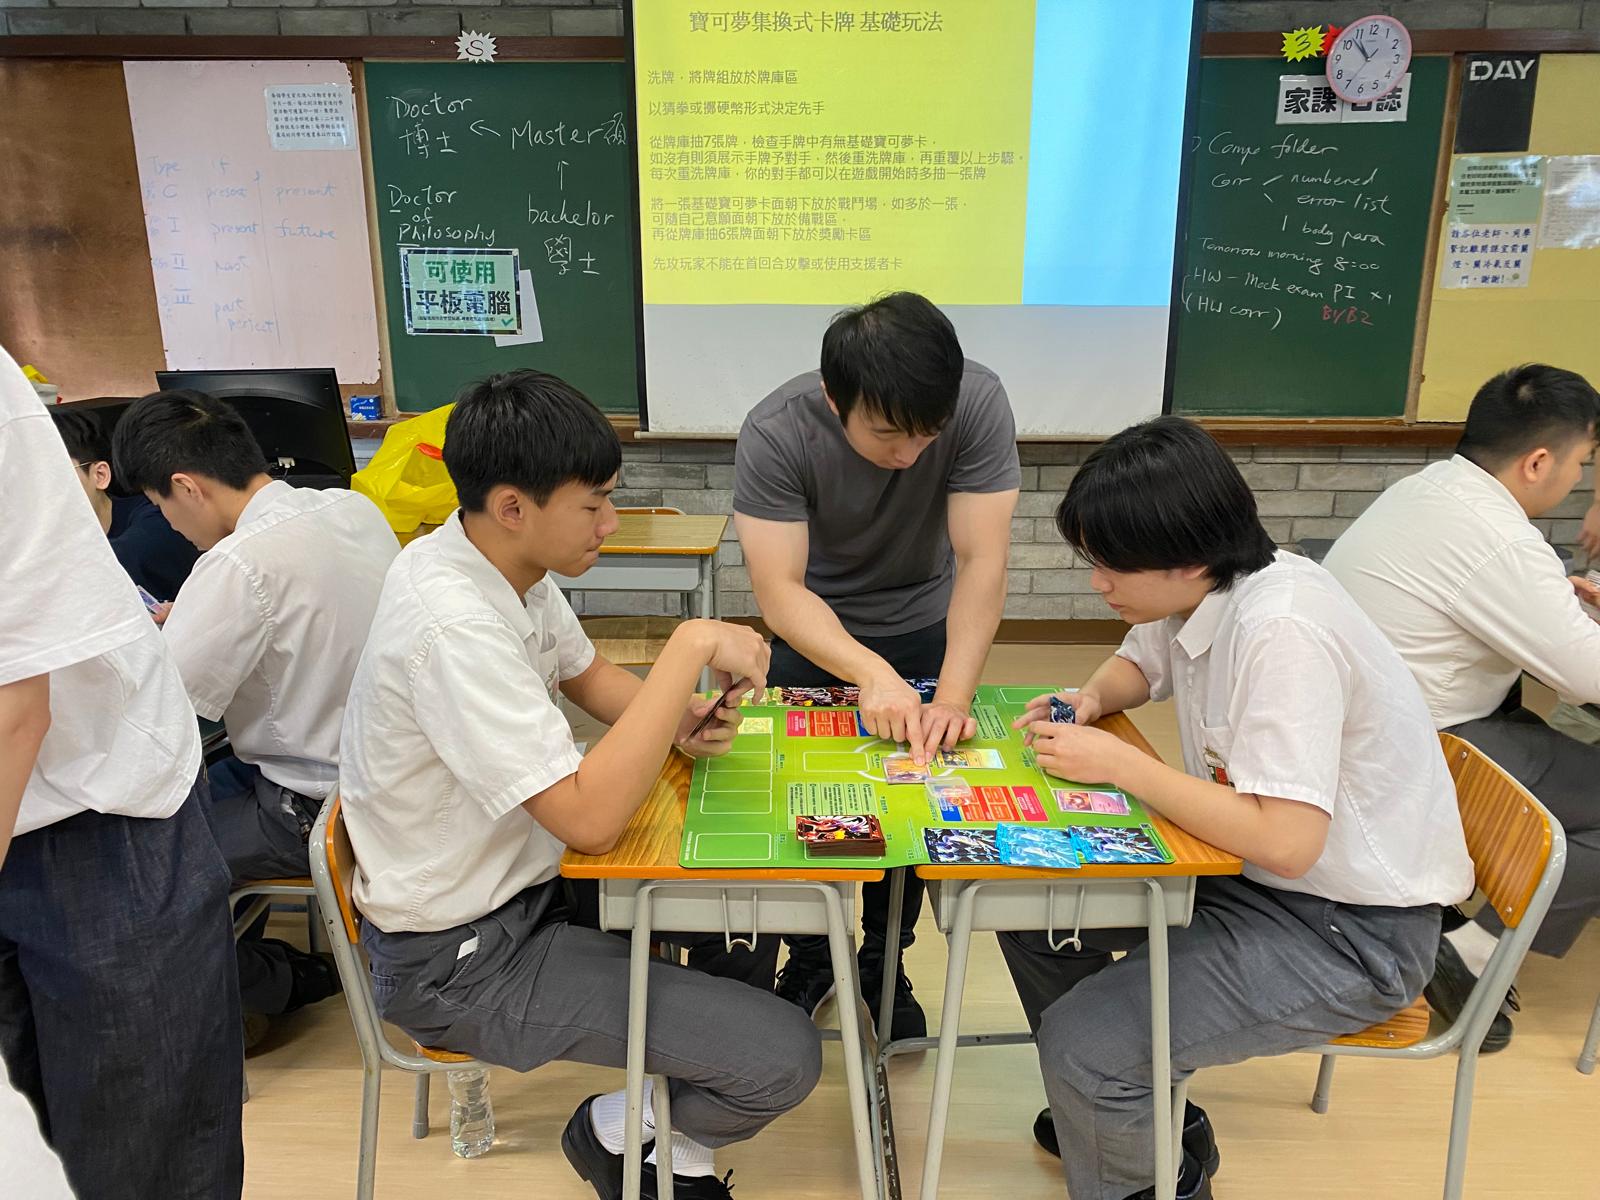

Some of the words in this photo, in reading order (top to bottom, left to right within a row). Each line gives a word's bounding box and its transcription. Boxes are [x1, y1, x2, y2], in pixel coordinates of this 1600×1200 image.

[689, 11, 855, 33] 寶可夢集換式卡牌
[860, 11, 943, 32] 基礎玩法
[1369, 24, 1380, 35] 12
[1295, 33, 1311, 49] 3
[1356, 28, 1364, 39] 11
[1385, 28, 1390, 39] 1
[1343, 40, 1353, 50] 10
[1392, 39, 1399, 50] 2
[1335, 54, 1341, 64] 9
[1393, 54, 1400, 64] 3
[1336, 69, 1343, 80] 8
[1384, 69, 1391, 80] 4
[1469, 59, 1535, 81] DAY
[1345, 80, 1352, 90] 7
[1357, 84, 1364, 94] 6
[1371, 80, 1379, 90] 5
[387, 92, 472, 119] Doctor
[649, 101, 825, 116] 以猜拳或擲硬幣形式決定先手
[399, 119, 457, 159] 博士
[511, 119, 604, 150] Master
[1271, 132, 1338, 159] folder
[1291, 168, 1379, 186] numbered
[387, 184, 457, 207] Doctor
[1297, 193, 1345, 207] error
[1354, 193, 1392, 215] list
[412, 207, 434, 224] of
[528, 194, 615, 227] bachelor
[274, 218, 337, 240] future
[398, 224, 496, 246] Philosophy
[652, 227, 872, 242] 再從牌庫抽6張牌面朝下放於獎勵卡區
[1302, 223, 1334, 245] body
[1342, 231, 1385, 248] para
[544, 234, 600, 275] 學士
[1200, 237, 1261, 257] Tomorrow
[1268, 250, 1325, 275] morning
[425, 259, 496, 285] 可使用
[653, 256, 903, 272] 先攻玩家不能在首回合攻擊或使用支援者卡
[1194, 266, 1222, 284] HW
[1245, 271, 1281, 292] Mock
[1288, 283, 1324, 299] exam
[416, 289, 511, 316] 平板電腦
